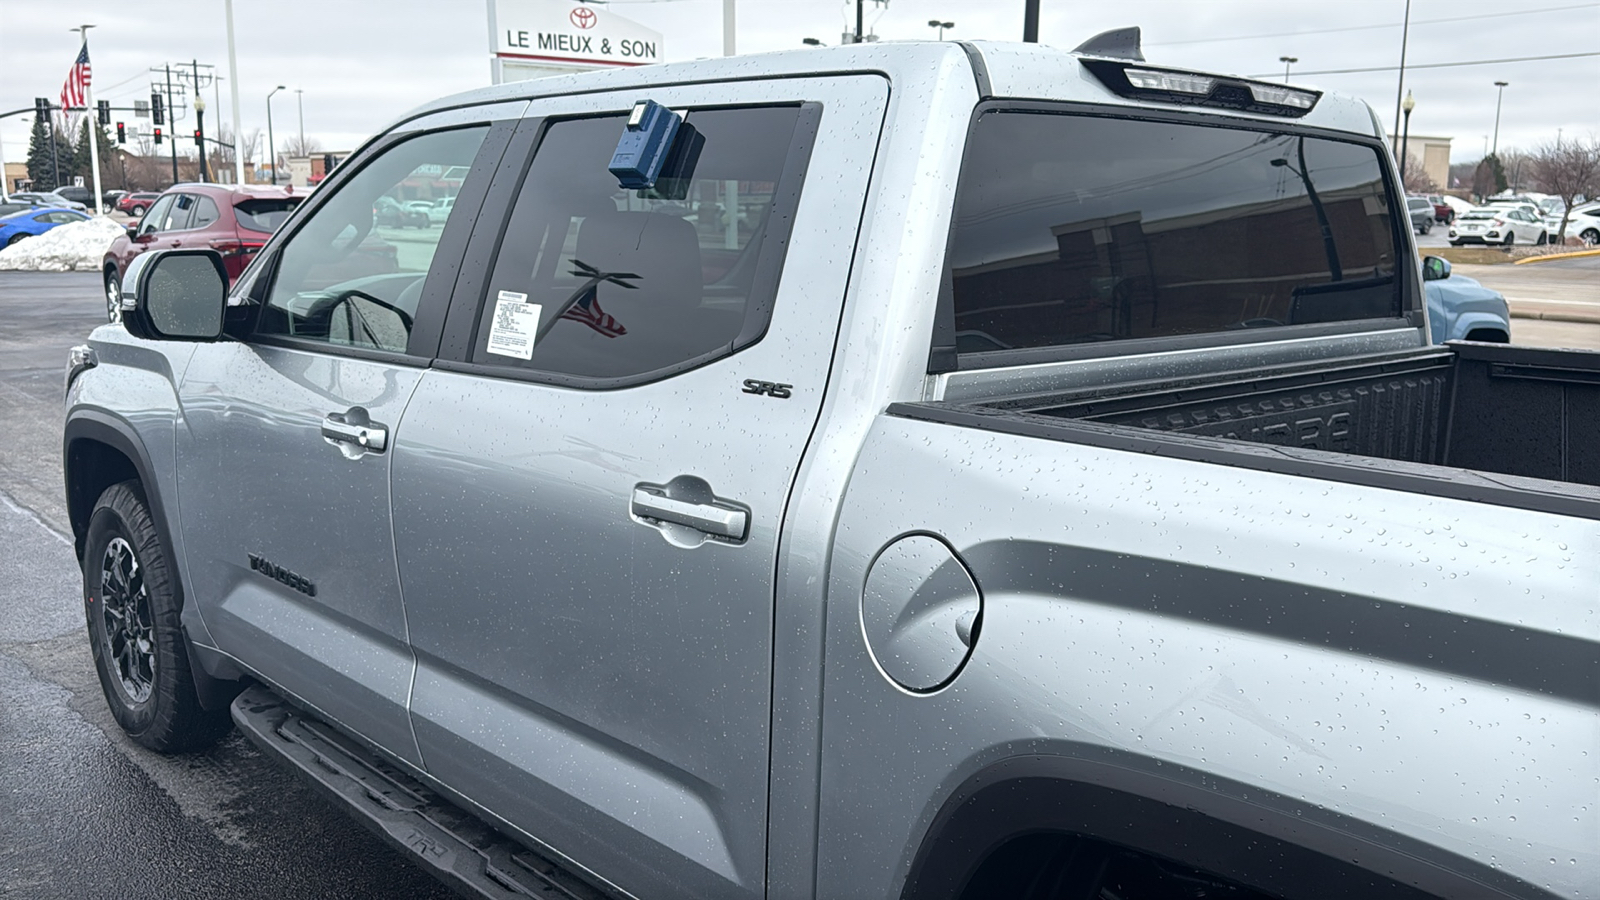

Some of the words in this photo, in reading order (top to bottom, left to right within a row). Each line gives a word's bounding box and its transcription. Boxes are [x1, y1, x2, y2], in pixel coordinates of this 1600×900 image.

[507, 30, 530, 48] LE
[538, 33, 593, 53] MIEUX
[601, 38, 612, 55] &
[621, 39, 657, 58] SON
[741, 378, 794, 399] SR5
